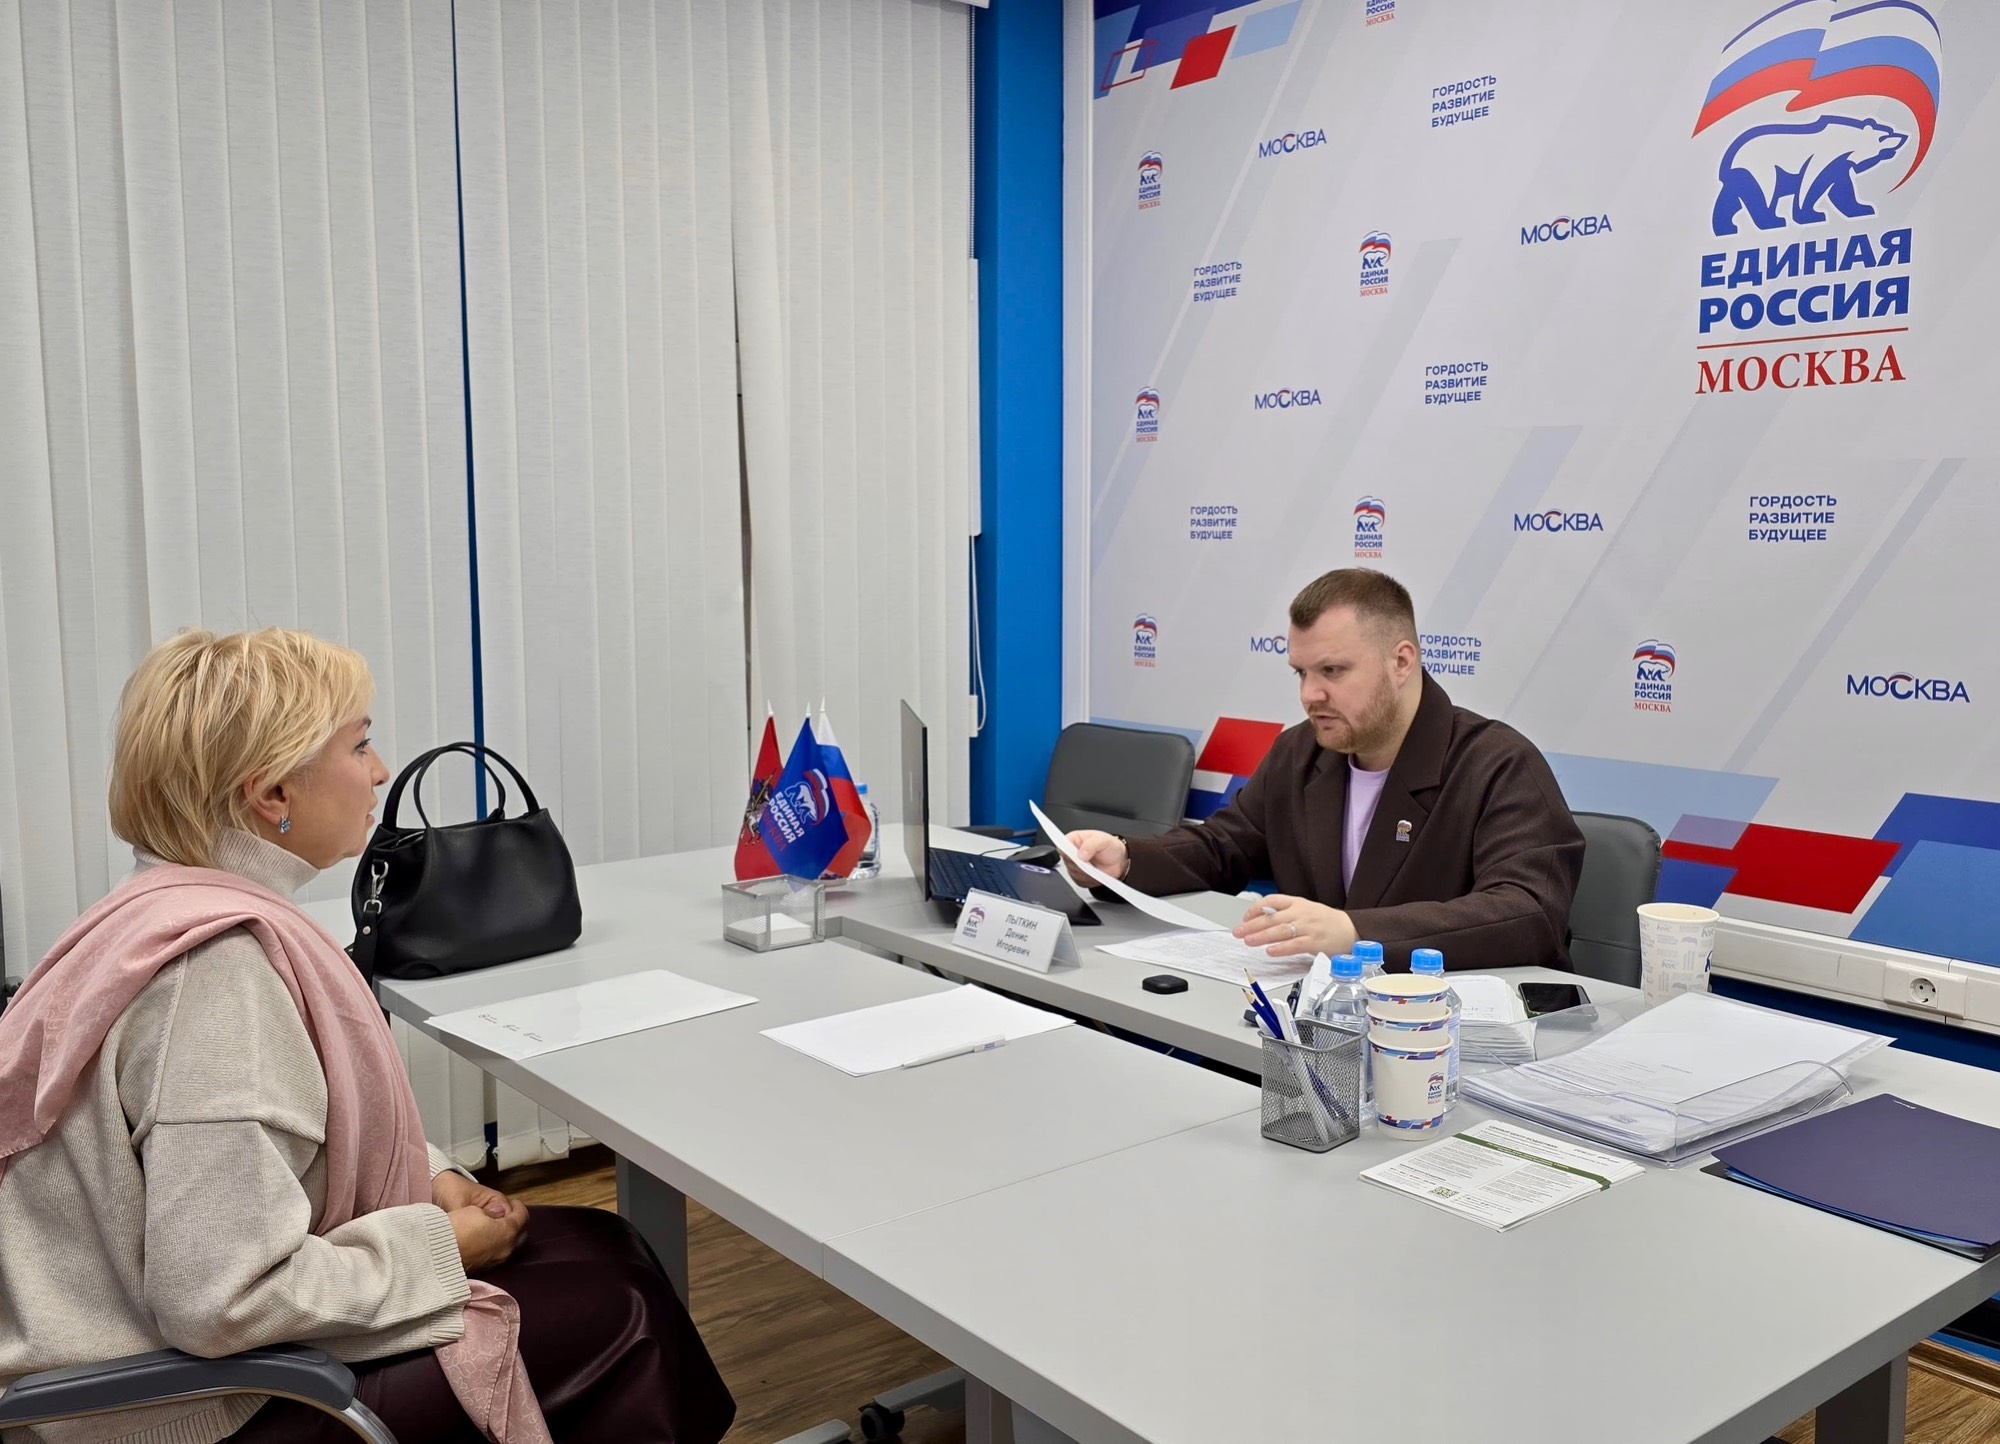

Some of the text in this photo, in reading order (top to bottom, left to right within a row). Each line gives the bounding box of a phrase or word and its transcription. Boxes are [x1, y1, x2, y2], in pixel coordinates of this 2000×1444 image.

[1366, 1, 1395, 16] РОССИЯ
[1432, 75, 1497, 98] ГОРДОСТЬ
[1432, 89, 1495, 113] РАЗВИТИЕ
[1432, 106, 1489, 128] БУДУЩЕЕ
[1259, 128, 1327, 158] МОСКВА
[1521, 214, 1612, 245] МОСКВА
[1701, 228, 1912, 288] ЕДИНАЯ
[1193, 261, 1242, 277] ГОРДОСТЬ
[1360, 269, 1389, 279] ЕДИНАЯ
[1193, 274, 1241, 289] РАЗВИТИЕ
[1360, 276, 1389, 286] РОССИЯ
[1193, 287, 1237, 302] БУДУЩЕЕ
[1360, 287, 1389, 297] МОСКВА
[1699, 276, 1910, 334] РОССИЯ
[1425, 361, 1488, 376] ГОРДОСТЬ
[1695, 345, 1906, 394] МОСКВА
[1425, 376, 1487, 390] РАЗВИТИЕ
[1254, 388, 1321, 409] МОСКВА
[1425, 391, 1481, 405] БУДУЩЕЕ
[1750, 495, 1837, 509] ГОРДОСТЬ
[1190, 505, 1238, 516] ГОРДОСТЬ
[1749, 512, 1835, 524] РАЗВИТИЕ
[1190, 518, 1237, 527] РАЗВИТИЕ
[1514, 509, 1603, 533] МОСКВА
[1190, 530, 1233, 541] БУДУЩЕЕ
[1748, 529, 1827, 542] БУДУЩЕЕ
[1354, 551, 1382, 559] МОСКВА
[1250, 636, 1289, 655] МОС
[1420, 634, 1482, 647] ГОРДОСТЬ
[1422, 662, 1475, 676] УДУЩЕЕ
[1634, 682, 1672, 692] ЕДИНАЯ
[1847, 672, 1970, 703] МОСКВА
[1634, 690, 1672, 700] РОССИЯ
[1634, 702, 1672, 713] МОСКВА
[768, 797, 797, 844] РОССИЯ
[775, 791, 805, 837] ЕДИНАЯ
[1005, 914, 1038, 930] ЛЫТКИН
[1005, 928, 1029, 942] Денис
[996, 938, 1031, 957] Игоревич
